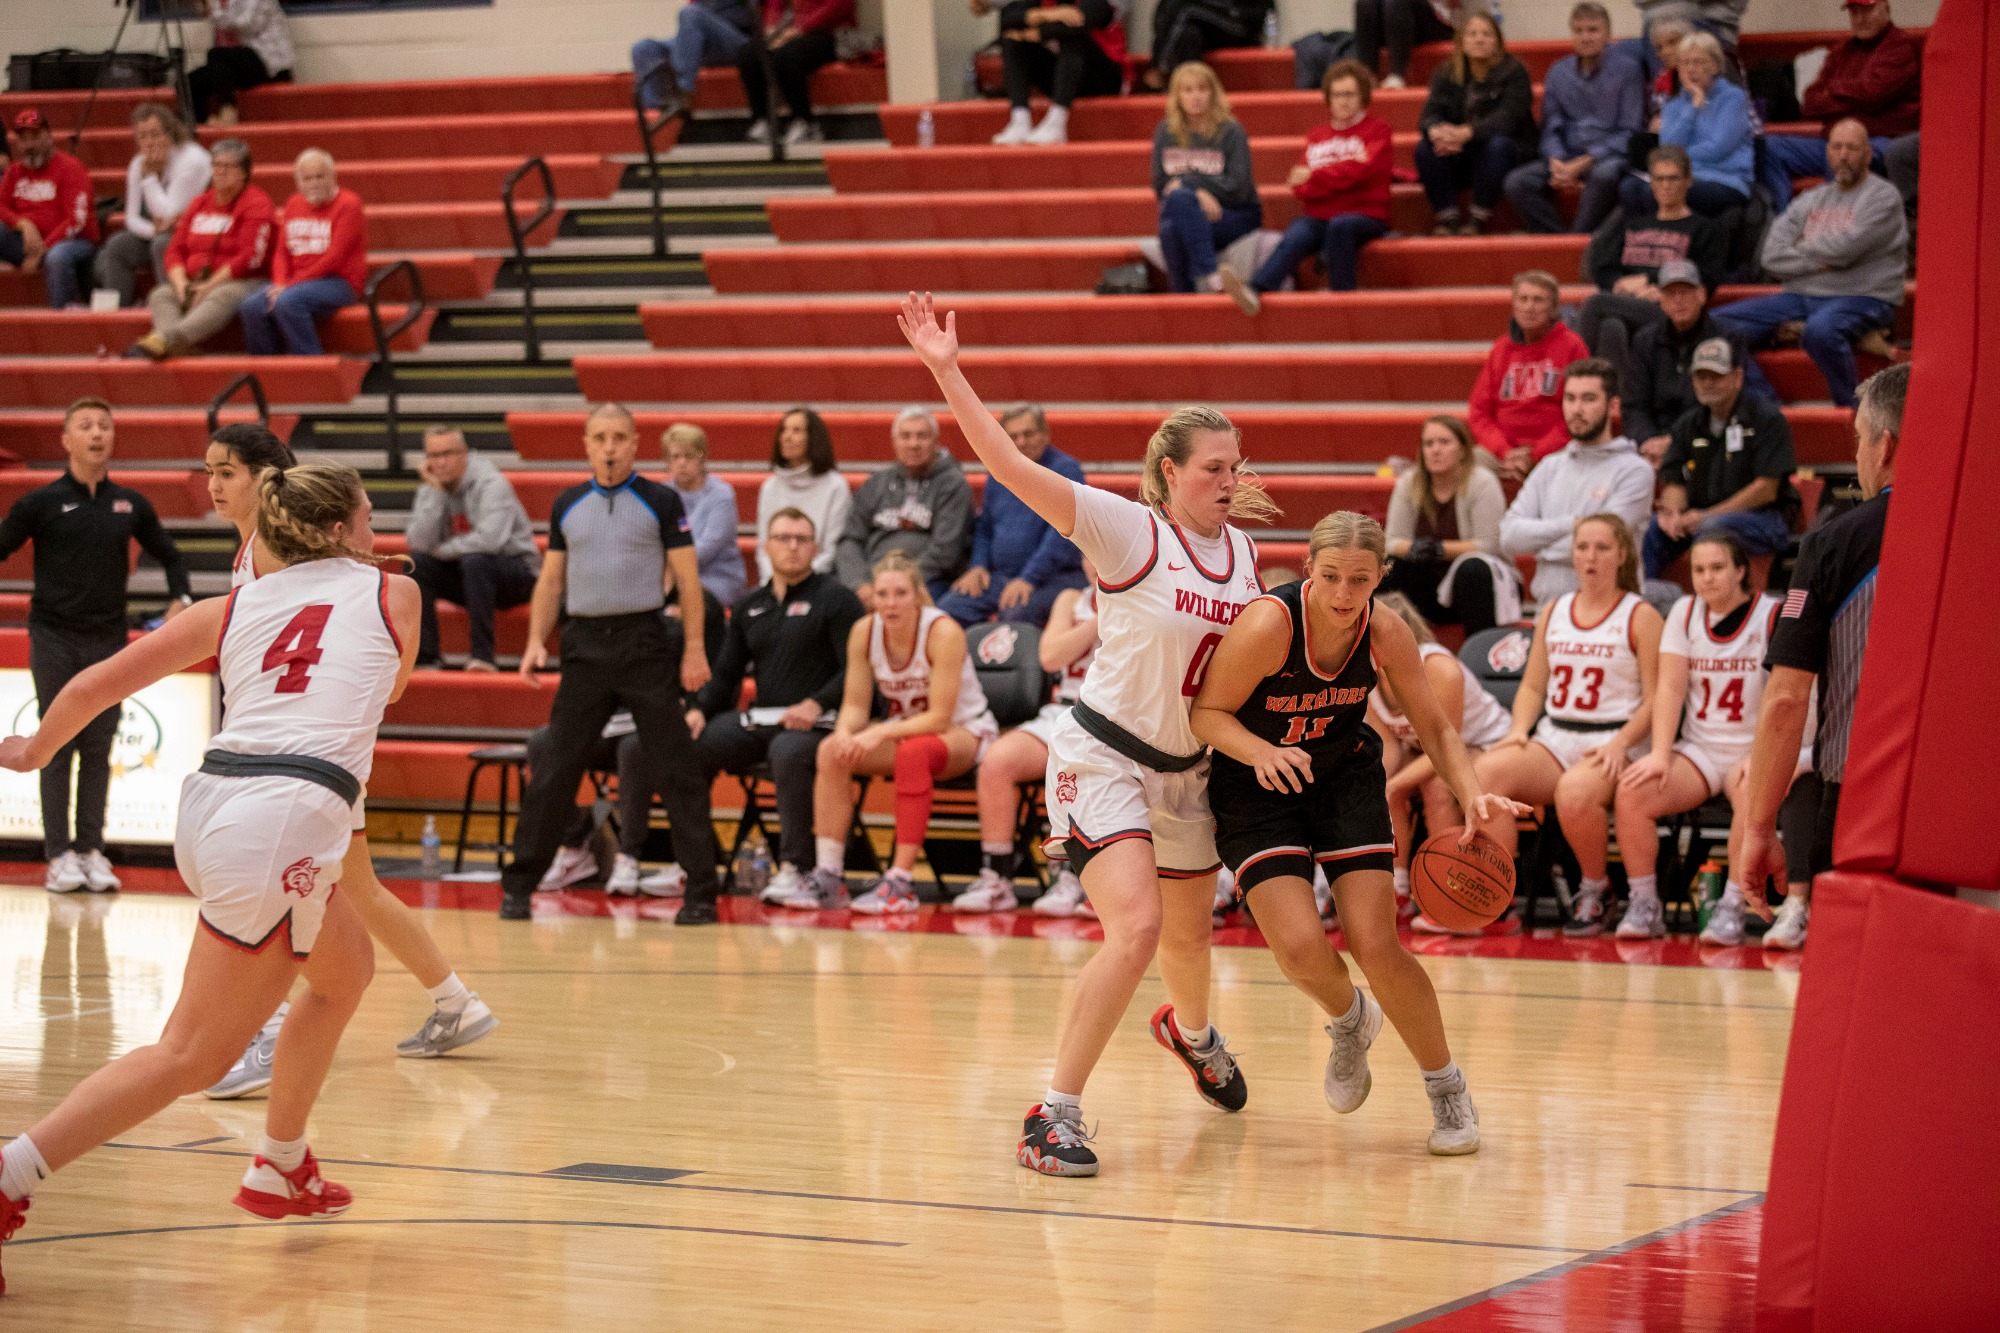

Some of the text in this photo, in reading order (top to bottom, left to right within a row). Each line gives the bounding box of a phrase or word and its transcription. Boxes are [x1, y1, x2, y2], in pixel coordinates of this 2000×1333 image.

[1175, 588, 1248, 626] WILDCA
[262, 604, 334, 693] 4
[1550, 642, 1614, 658] WILDCATS
[1689, 656, 1757, 673] WILDCATS
[1265, 687, 1367, 713] WARRIORS
[1551, 665, 1605, 711] 33
[1696, 677, 1745, 722] 14
[1446, 866, 1501, 902] LEGACY
